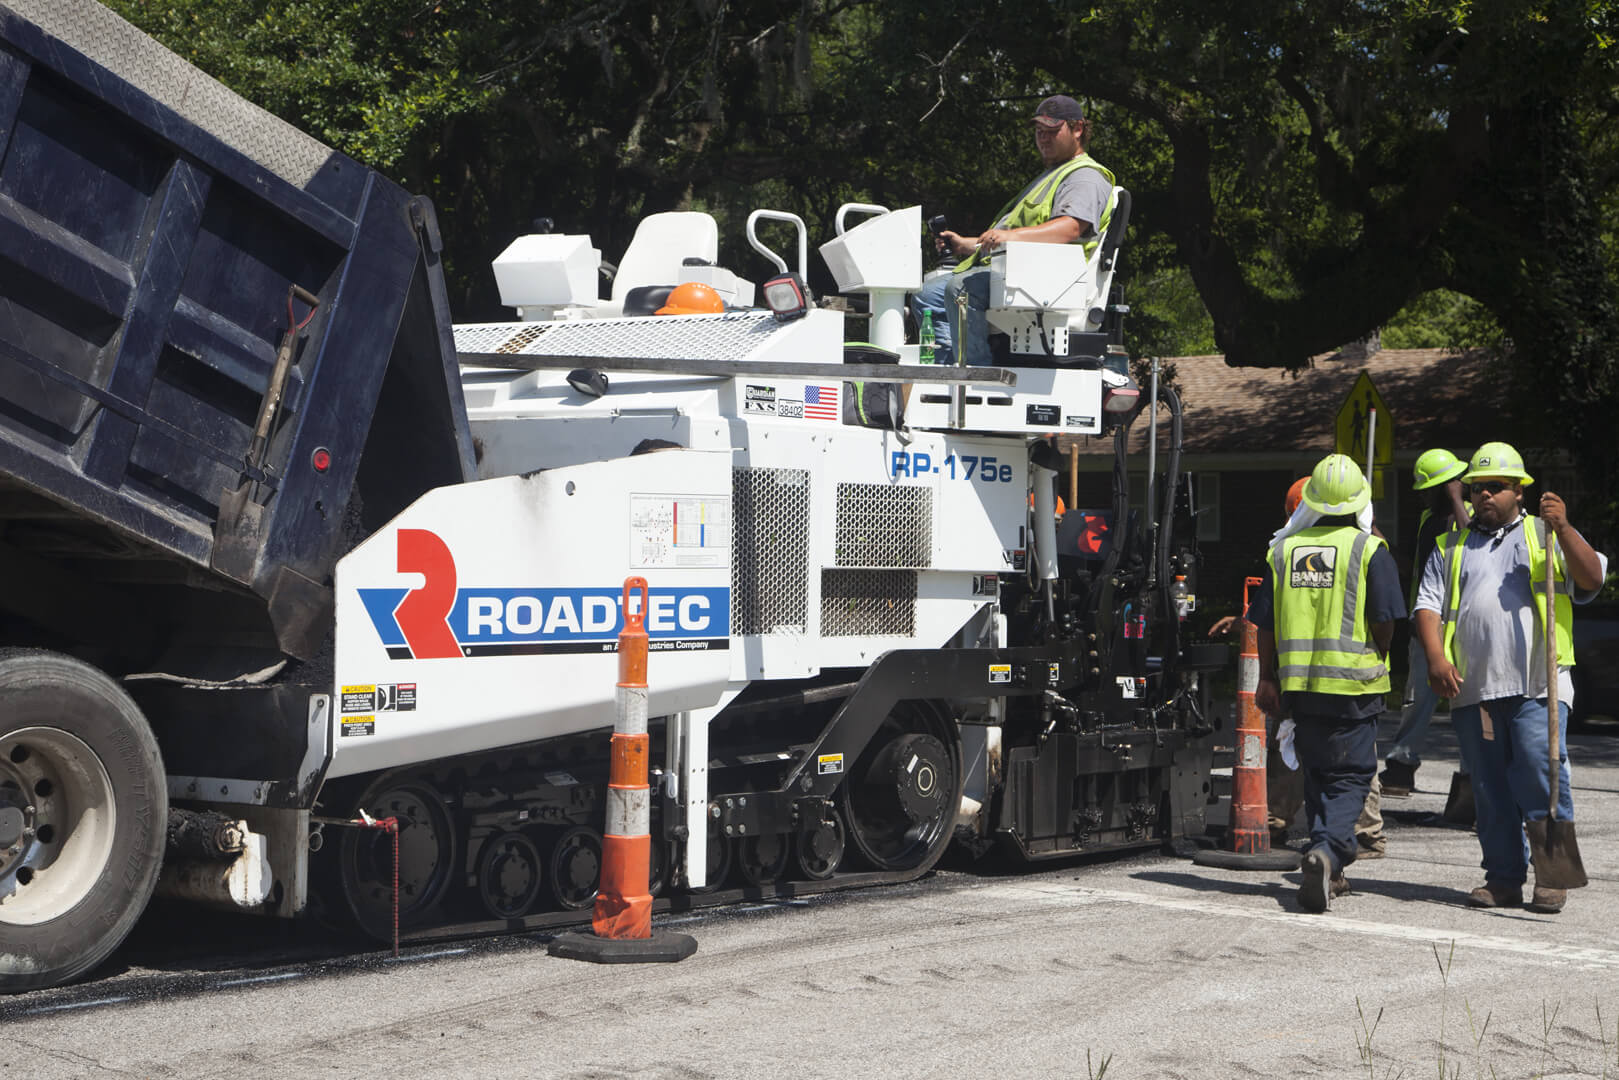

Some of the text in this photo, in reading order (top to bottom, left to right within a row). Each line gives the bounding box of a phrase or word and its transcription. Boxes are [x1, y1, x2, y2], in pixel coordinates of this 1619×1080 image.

[779, 404, 803, 416] 38402
[1291, 571, 1334, 582] BANKS
[467, 594, 711, 636] ROADTEC
[602, 643, 613, 652] an
[675, 640, 709, 650] Company
